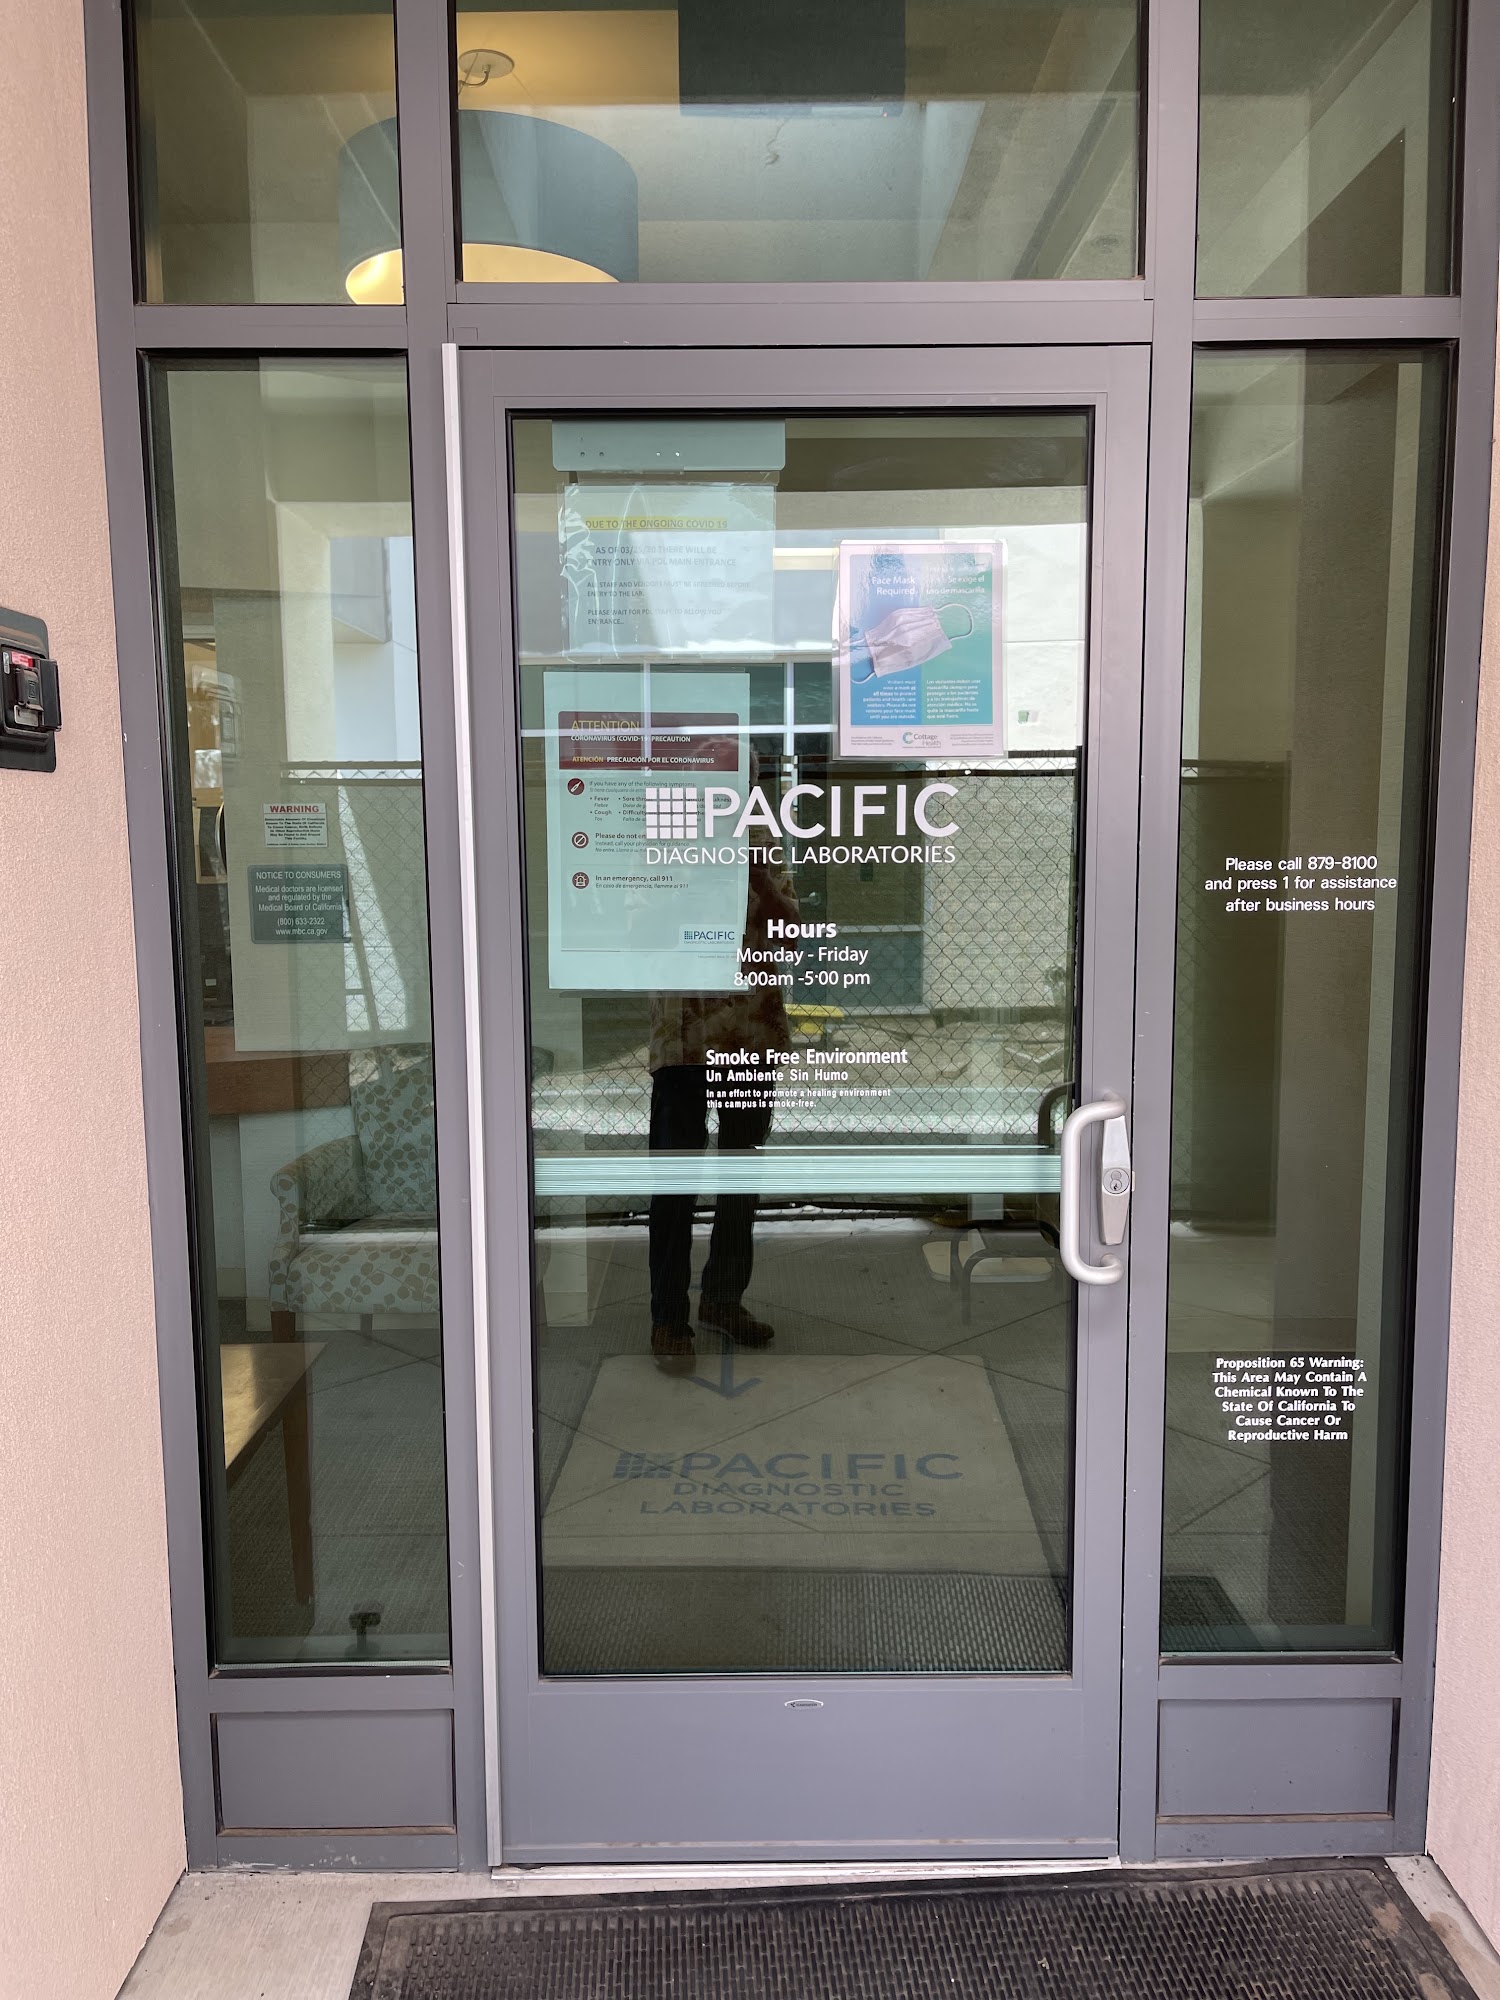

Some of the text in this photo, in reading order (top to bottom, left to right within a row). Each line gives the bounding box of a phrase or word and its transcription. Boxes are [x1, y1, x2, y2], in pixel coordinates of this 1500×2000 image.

[586, 520, 728, 528] DUE TO THE ONGOING COVID 19
[872, 576, 915, 585] Face Mask
[877, 587, 915, 596] Required
[572, 720, 640, 732] ATTENTION
[704, 782, 960, 839] PACIFIC
[646, 846, 955, 865] DIAGNOSTIC LABORATORIES
[1225, 856, 1378, 871] Please call 879-8100
[1205, 875, 1397, 892] and press 1 for assistance
[282, 894, 311, 902] regulated
[312, 894, 320, 902] by
[1225, 897, 1375, 912] after business hours
[277, 918, 294, 926] (800)
[767, 918, 837, 939] Hours
[275, 928, 328, 936] www.mbc.ca.gov
[694, 931, 735, 940] PACIFIC
[736, 947, 804, 966] Monday
[819, 945, 868, 965] Friday
[734, 971, 794, 986] 8:00am
[843, 974, 870, 988] pm
[706, 1048, 908, 1065] Smoke Free Environment
[706, 1069, 848, 1082] Un Ambiente Sin Humo
[706, 1089, 714, 1098] In
[729, 1089, 751, 1098] effort
[764, 1091, 797, 1099] promote
[807, 1089, 837, 1099] healing
[840, 1089, 891, 1097] environment
[707, 1100, 722, 1108] this
[725, 1101, 757, 1109] campus
[1216, 1357, 1364, 1371] Proposition 65 Warning:
[1212, 1371, 1367, 1385] This Area May Contain A
[1215, 1386, 1364, 1397] Chemical Known To The
[1222, 1400, 1356, 1412] State Of California To
[1236, 1415, 1341, 1426] Cause Cancer Or
[1228, 1429, 1348, 1442] Reproductive Harm
[680, 1452, 963, 1480] PACIFIC
[673, 1482, 905, 1497] DIAGNOSTIC
[639, 1501, 936, 1516] LABORATORIES
